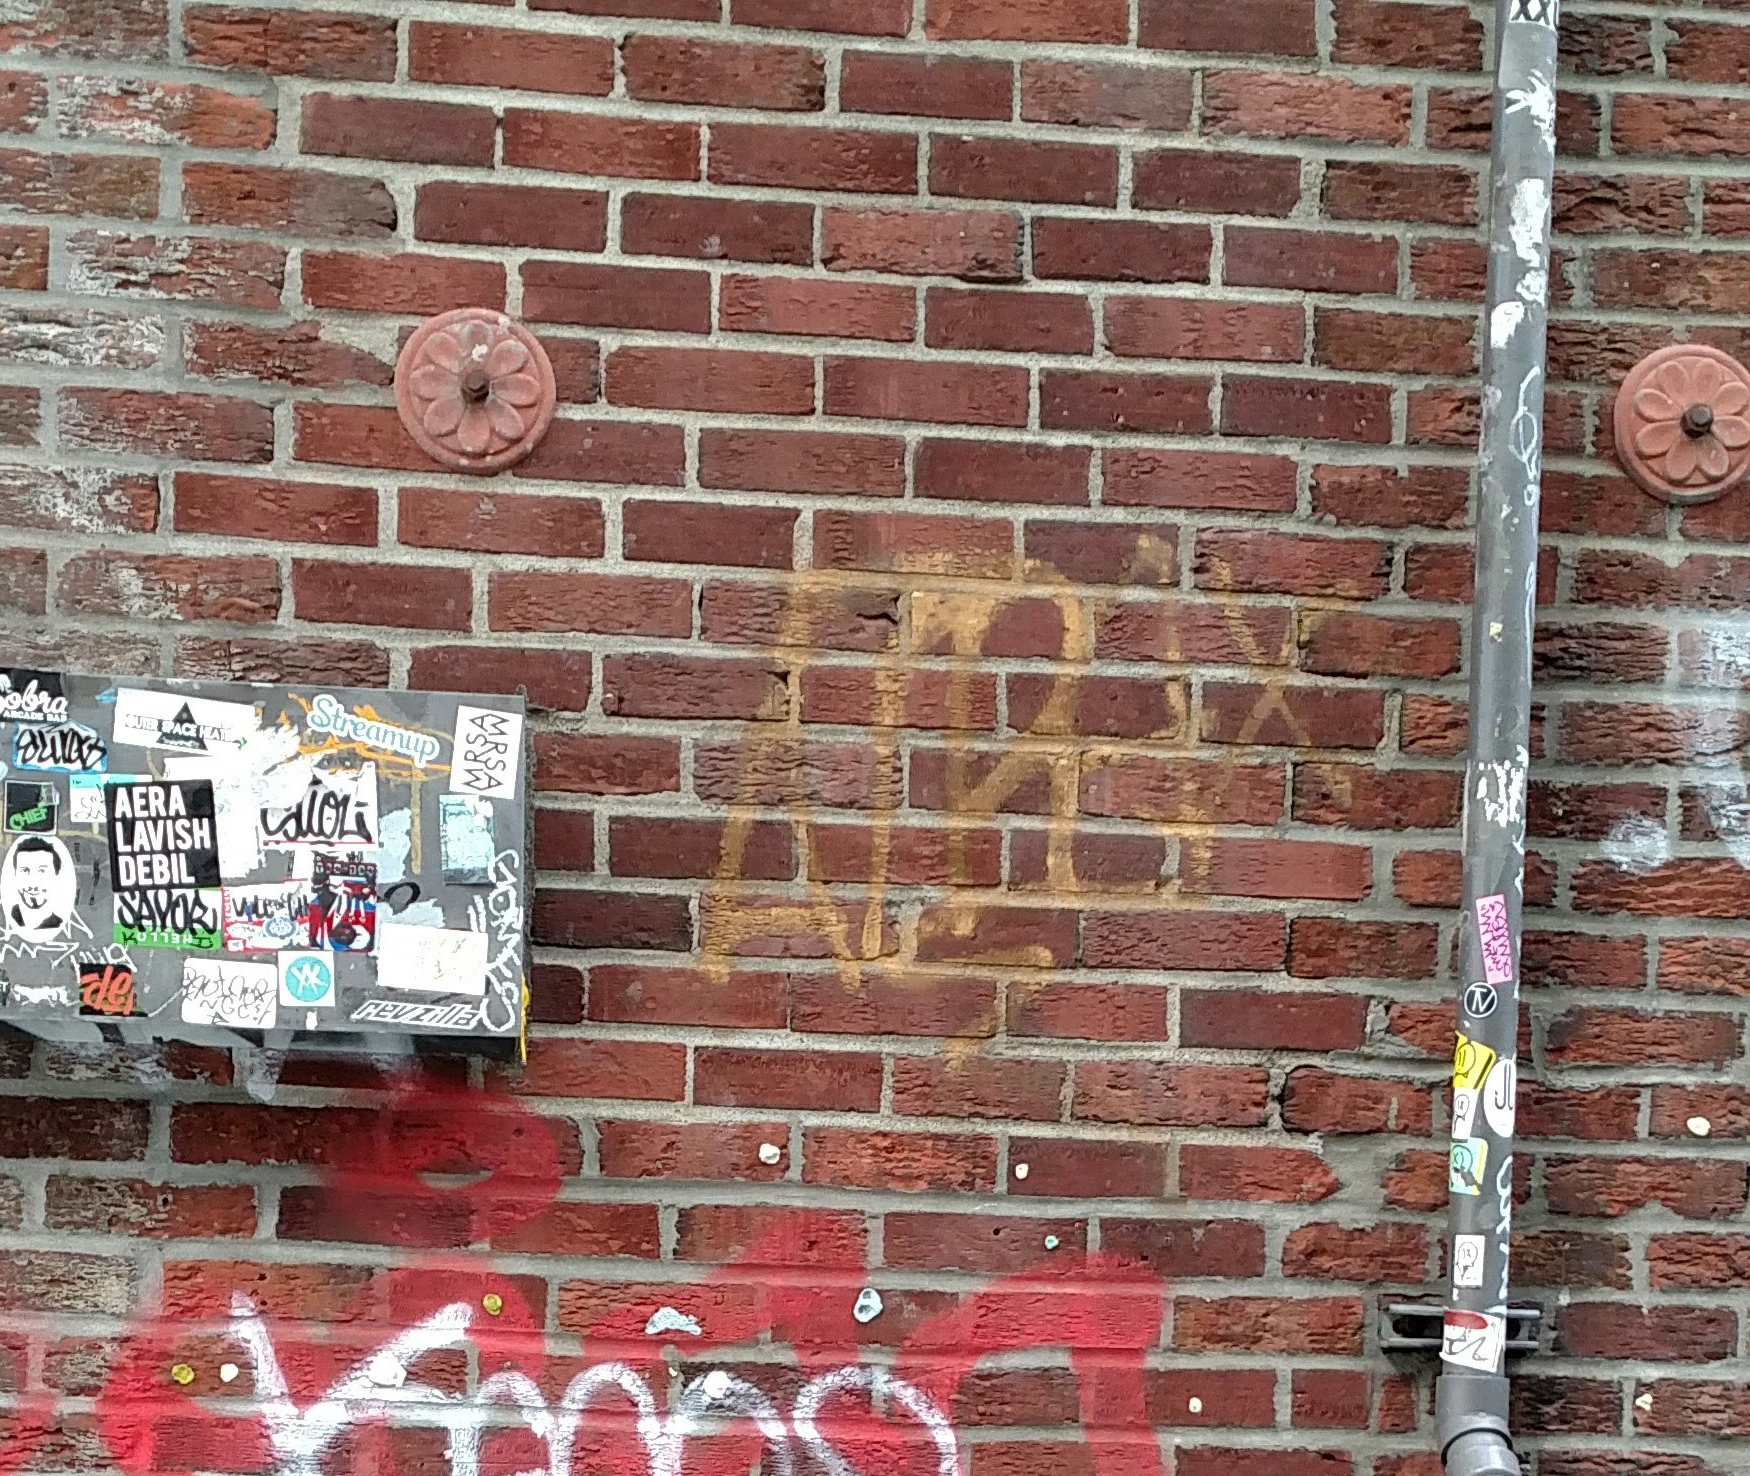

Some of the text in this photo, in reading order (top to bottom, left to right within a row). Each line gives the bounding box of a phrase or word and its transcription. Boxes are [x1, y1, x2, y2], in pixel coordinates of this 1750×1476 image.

[3, 710, 68, 722] ARCADE BAR
[161, 719, 198, 737] SPACE
[309, 696, 438, 763] Streamup
[115, 785, 186, 818] AERA
[9, 806, 49, 831] CHIEF
[116, 818, 212, 852] LAVISH
[118, 852, 196, 886] DEBIL
[136, 932, 193, 945] HELLO
